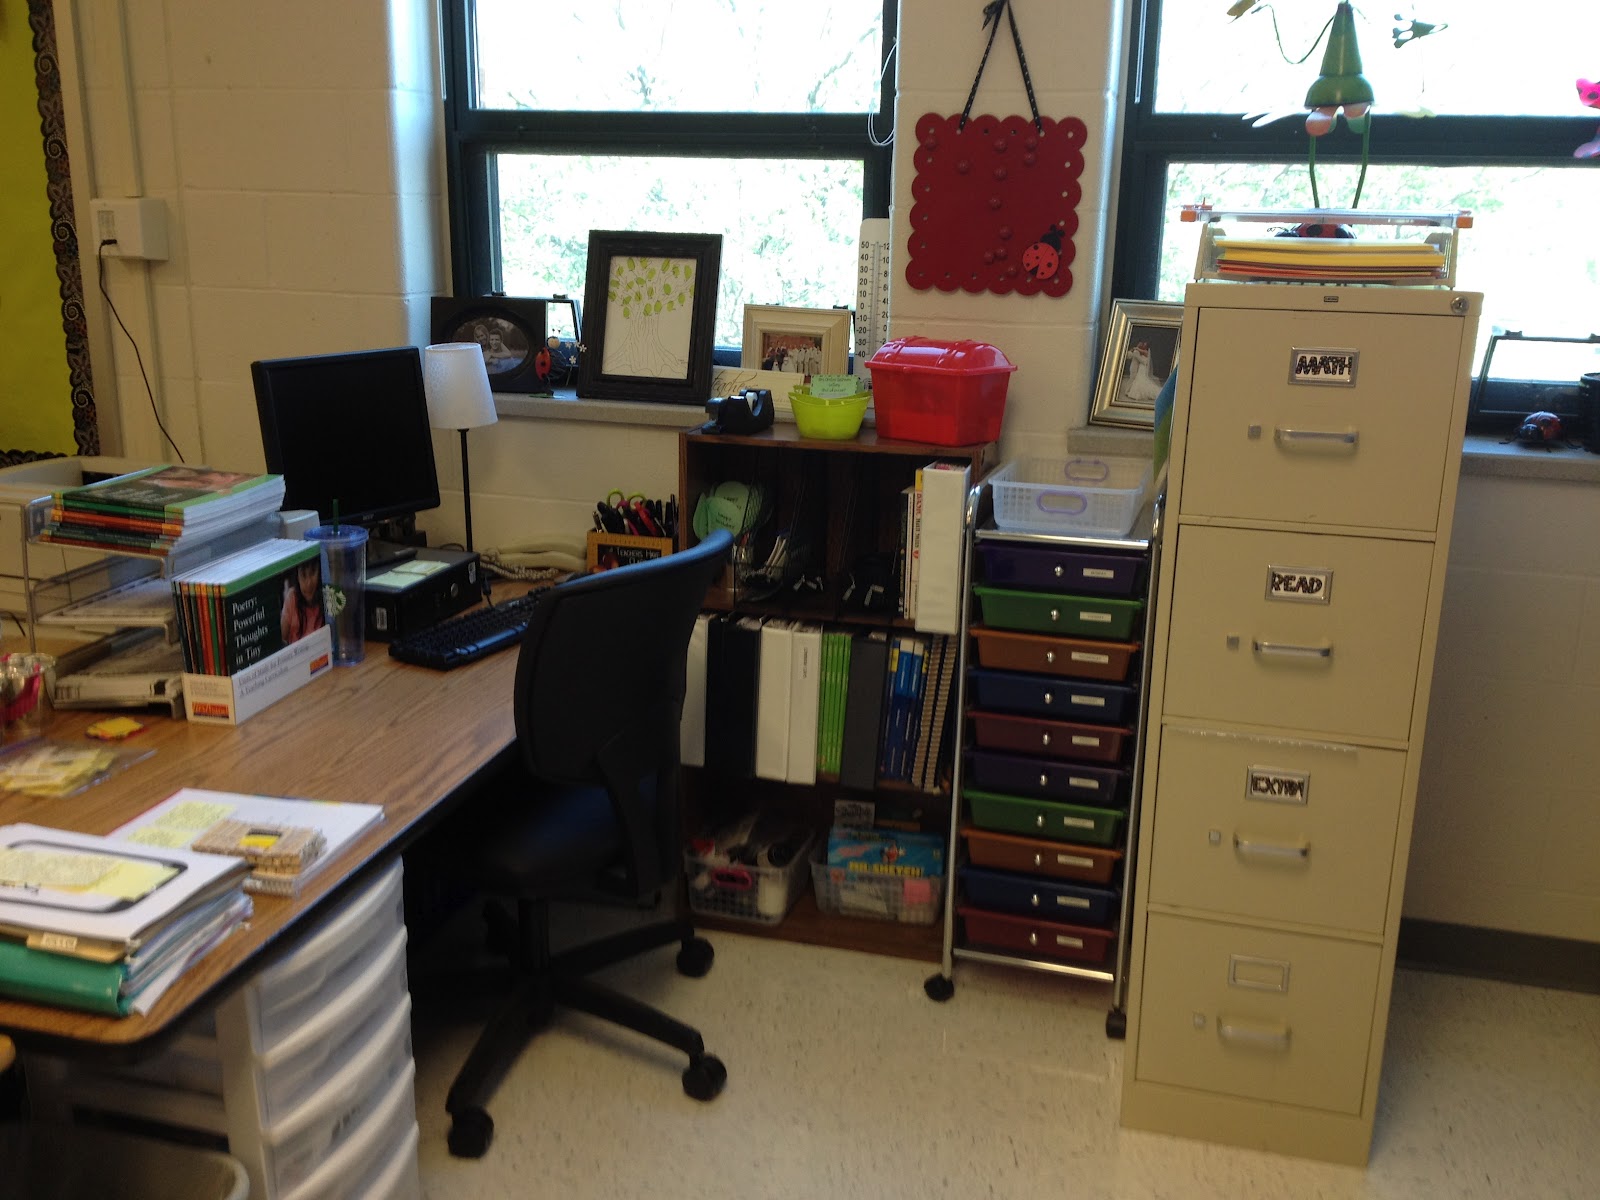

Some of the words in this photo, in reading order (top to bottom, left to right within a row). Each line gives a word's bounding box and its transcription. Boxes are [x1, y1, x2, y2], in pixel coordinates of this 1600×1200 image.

[1295, 355, 1353, 375] MATH
[1271, 571, 1323, 594] READ
[232, 596, 258, 616] Poetry:
[233, 606, 266, 633] Powerful
[234, 625, 269, 648] Thoughts
[236, 654, 244, 665] in
[245, 645, 262, 662] Tiny
